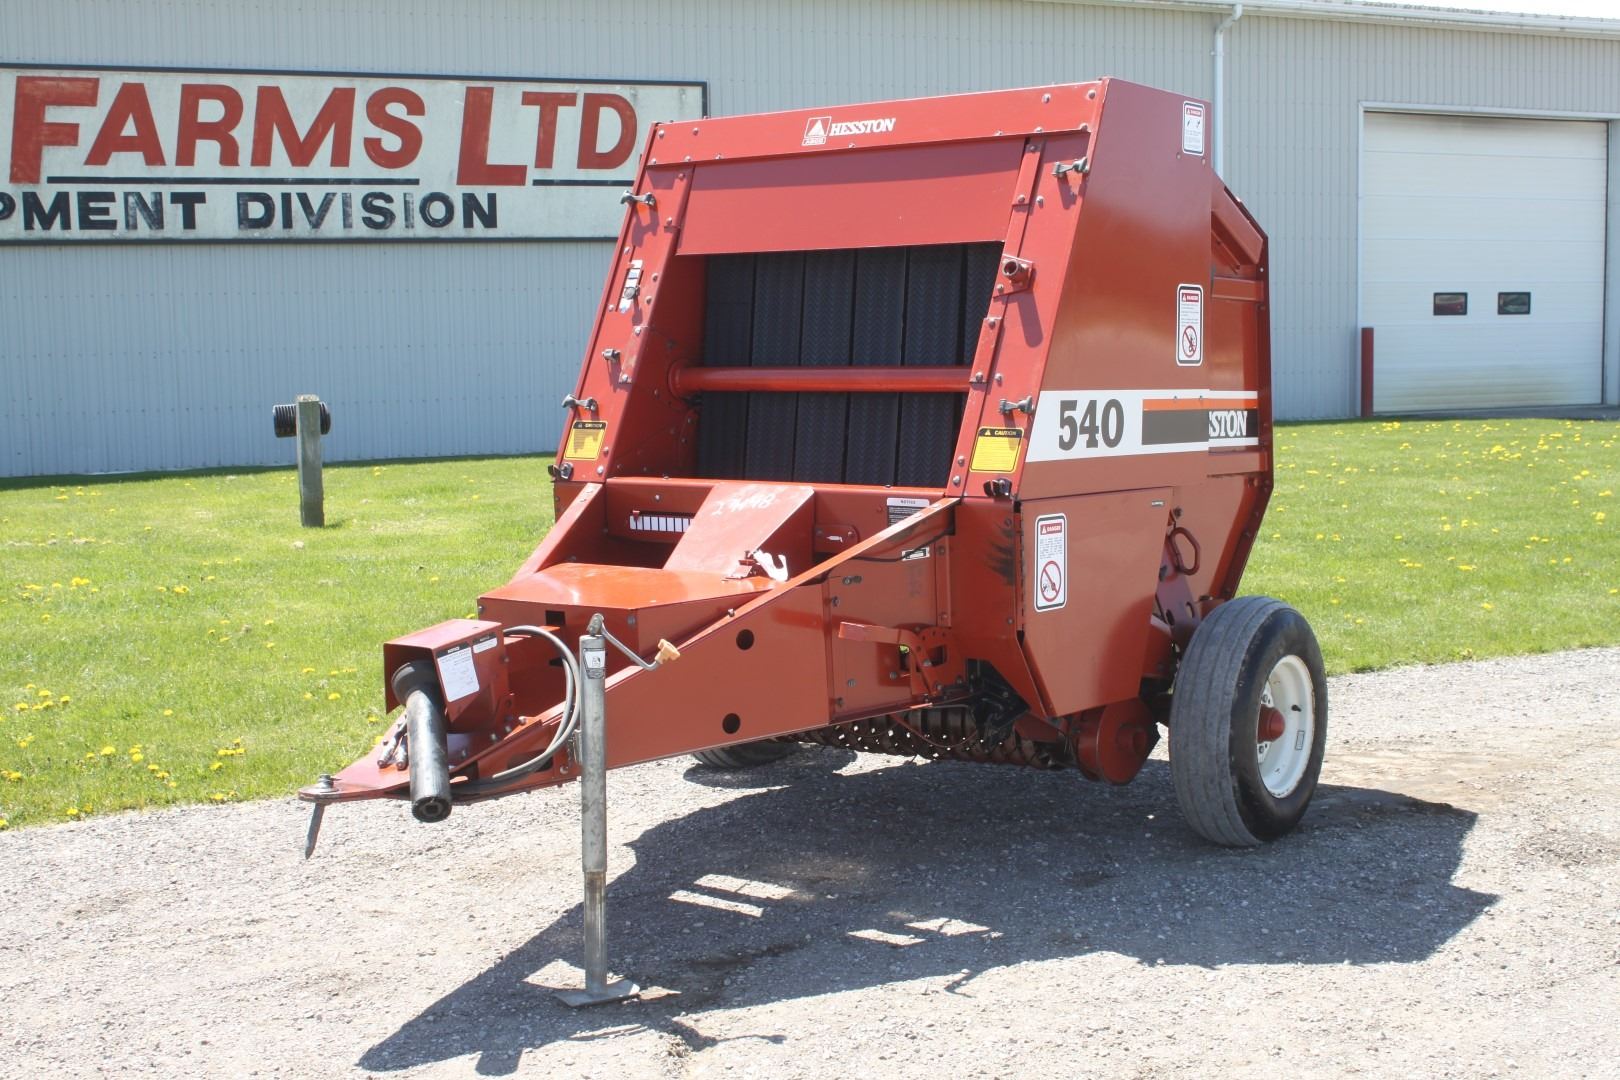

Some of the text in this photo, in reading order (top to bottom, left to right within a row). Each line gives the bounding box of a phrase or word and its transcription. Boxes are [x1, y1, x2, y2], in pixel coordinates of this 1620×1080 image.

[9, 75, 637, 187] FARMS LTD
[829, 118, 896, 136] HESSTON
[236, 192, 498, 230] DIVISION
[1058, 398, 1125, 451] 540
